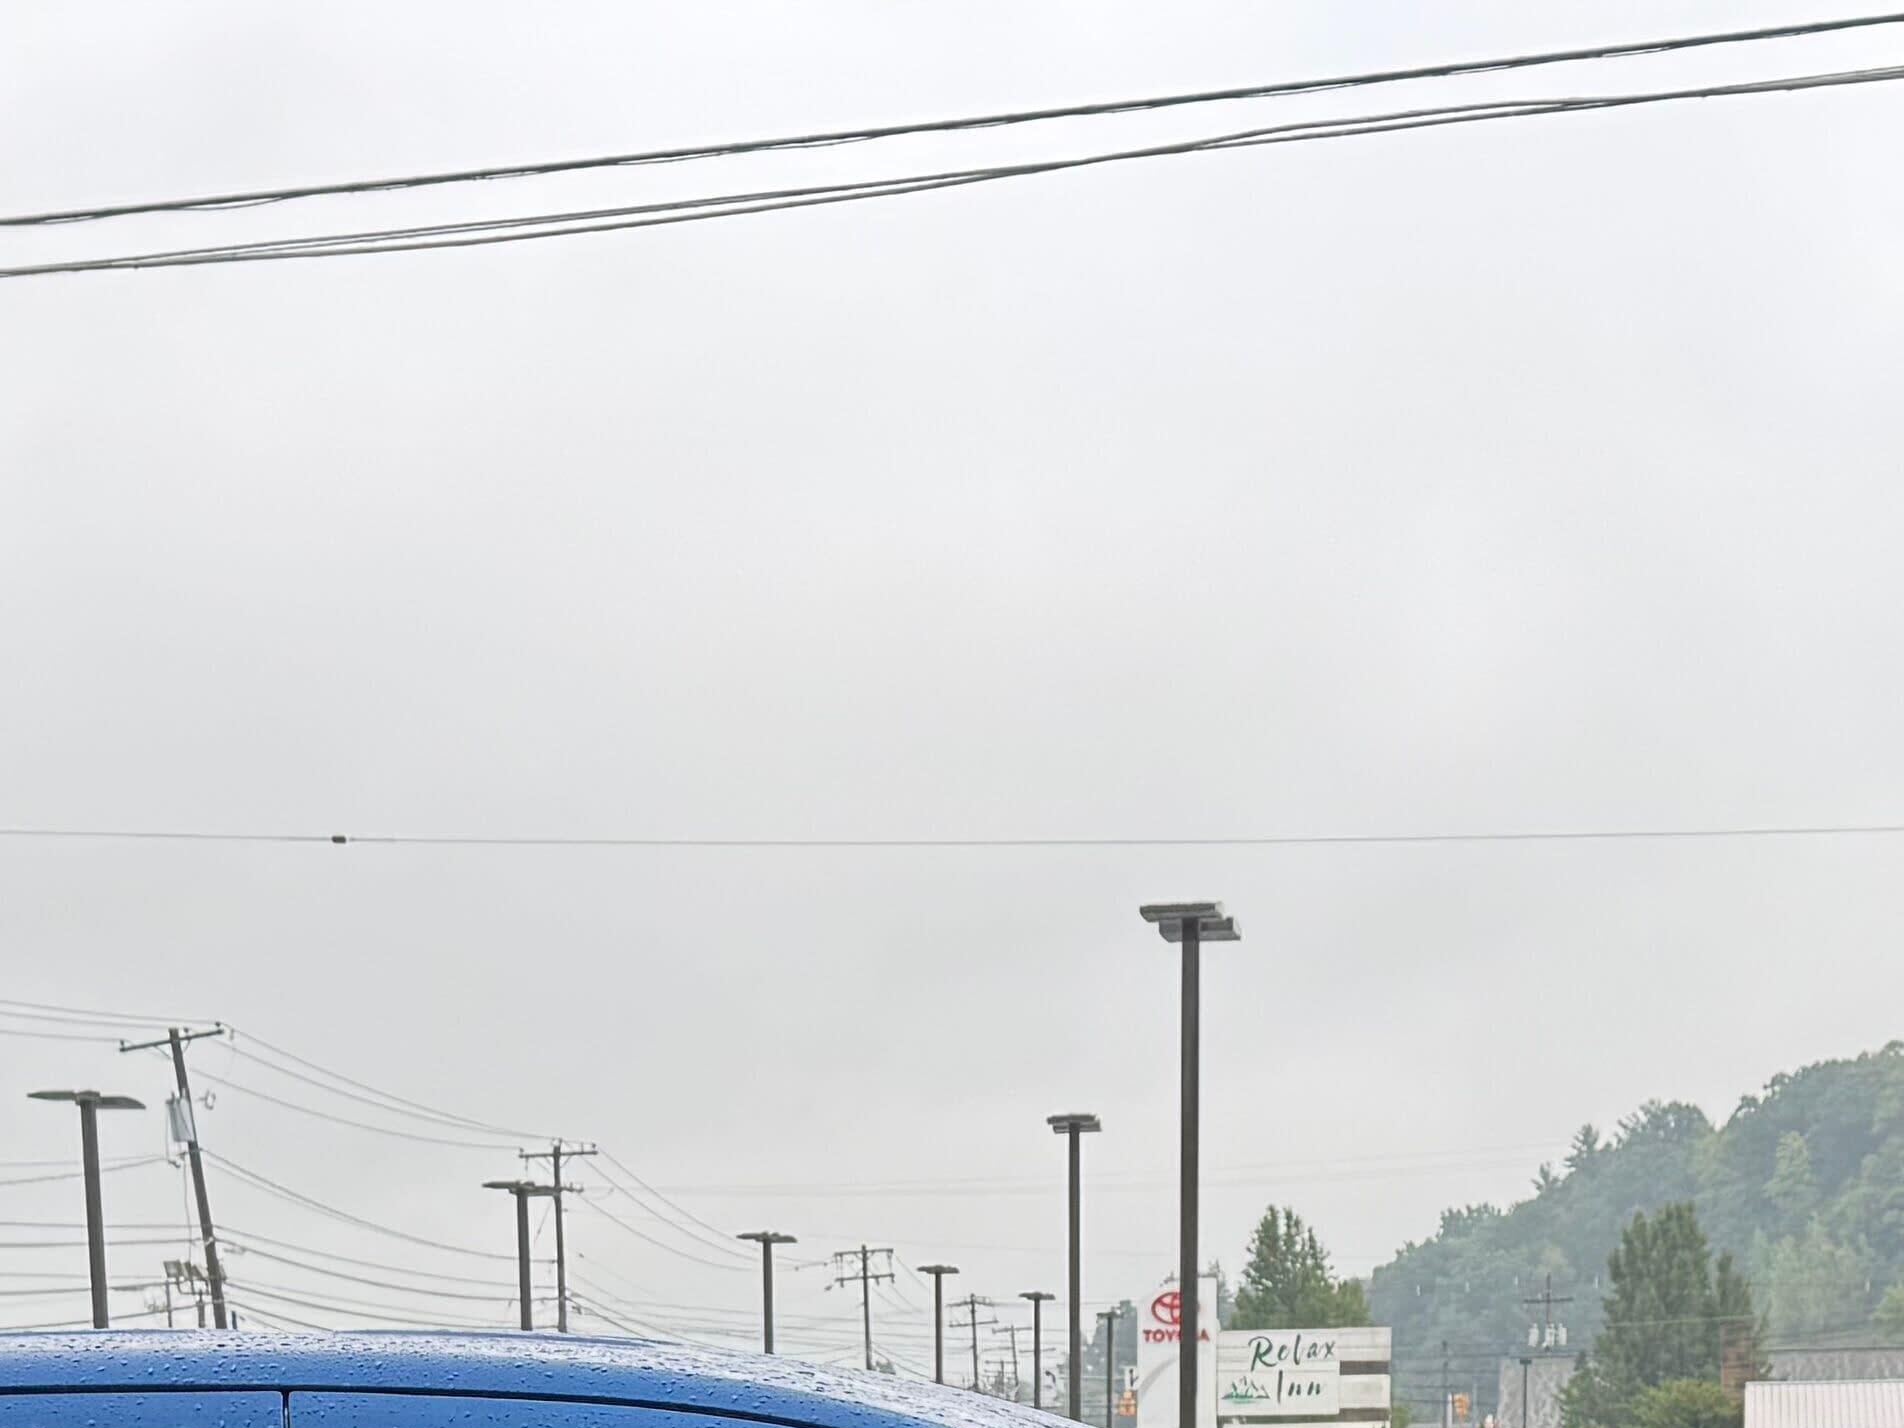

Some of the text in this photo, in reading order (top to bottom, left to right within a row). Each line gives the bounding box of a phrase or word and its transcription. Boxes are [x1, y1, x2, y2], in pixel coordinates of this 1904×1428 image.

[1142, 1328, 1210, 1343] TOYA
[1248, 1333, 1337, 1373] Relax
[1276, 1369, 1322, 1404] Inn
